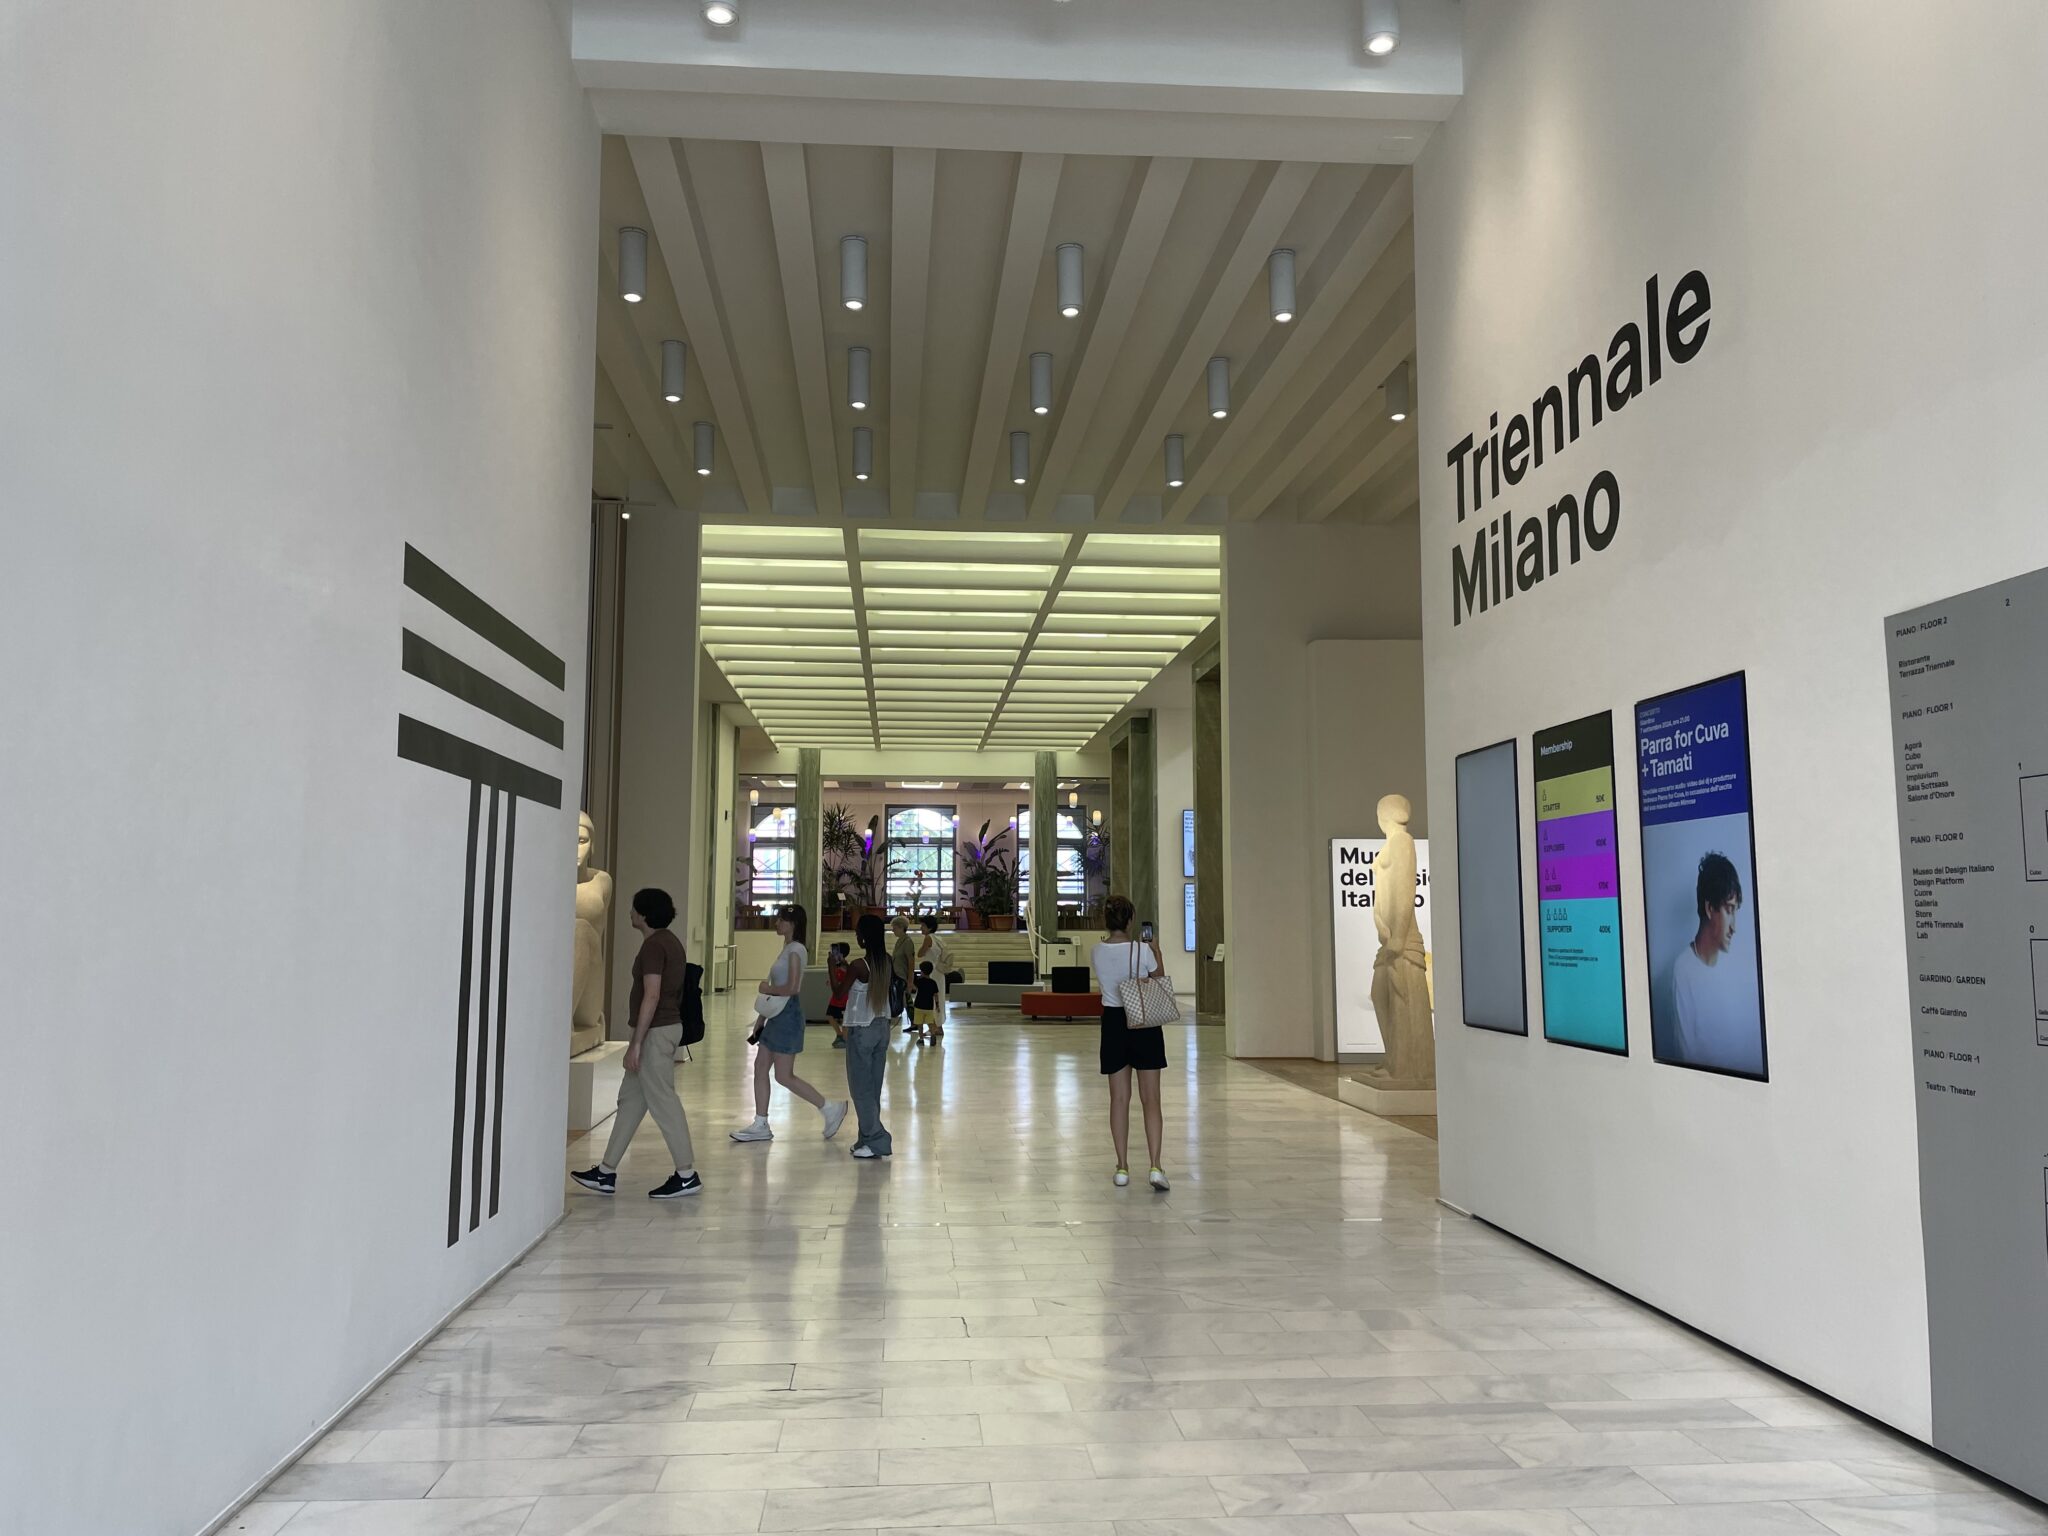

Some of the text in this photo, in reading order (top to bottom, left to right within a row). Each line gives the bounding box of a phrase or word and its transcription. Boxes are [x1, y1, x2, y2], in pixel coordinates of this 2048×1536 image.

[1447, 269, 1711, 524] Triennale
[1452, 470, 1620, 627] Milano
[2005, 598, 2010, 606] 2
[1896, 616, 1948, 638] PIANO FLOOR 2
[1898, 654, 1930, 668] Ristorante
[1899, 659, 1955, 678] Terrazza Triennale
[1902, 708, 1922, 720] PIANO
[1926, 704, 1949, 714] FLOOR
[1641, 722, 1729, 756] Parra for Cuva
[1540, 739, 1572, 757] Membership
[1905, 752, 1921, 760] Cubo
[1650, 750, 1692, 778] Tamati
[1906, 762, 1923, 771] Curva
[1906, 771, 1938, 782] Impluvium
[1921, 781, 1949, 790] Sottsass
[1908, 793, 1928, 802] Salone
[1910, 835, 1931, 844] PIANO
[1935, 833, 1958, 842] FLOOR
[1945, 866, 1967, 875] Design
[1969, 865, 1994, 873] Italiano
[1340, 869, 1373, 886] del
[1913, 877, 1964, 887] Design Platform
[1920, 974, 1986, 985] GIARDINO GARDEN
[1940, 1008, 1967, 1017] Giardino
[1924, 1049, 1944, 1059] PIANO
[1949, 1052, 1972, 1062] FLOOR
[1926, 1082, 1976, 1096] Teatro Theater
